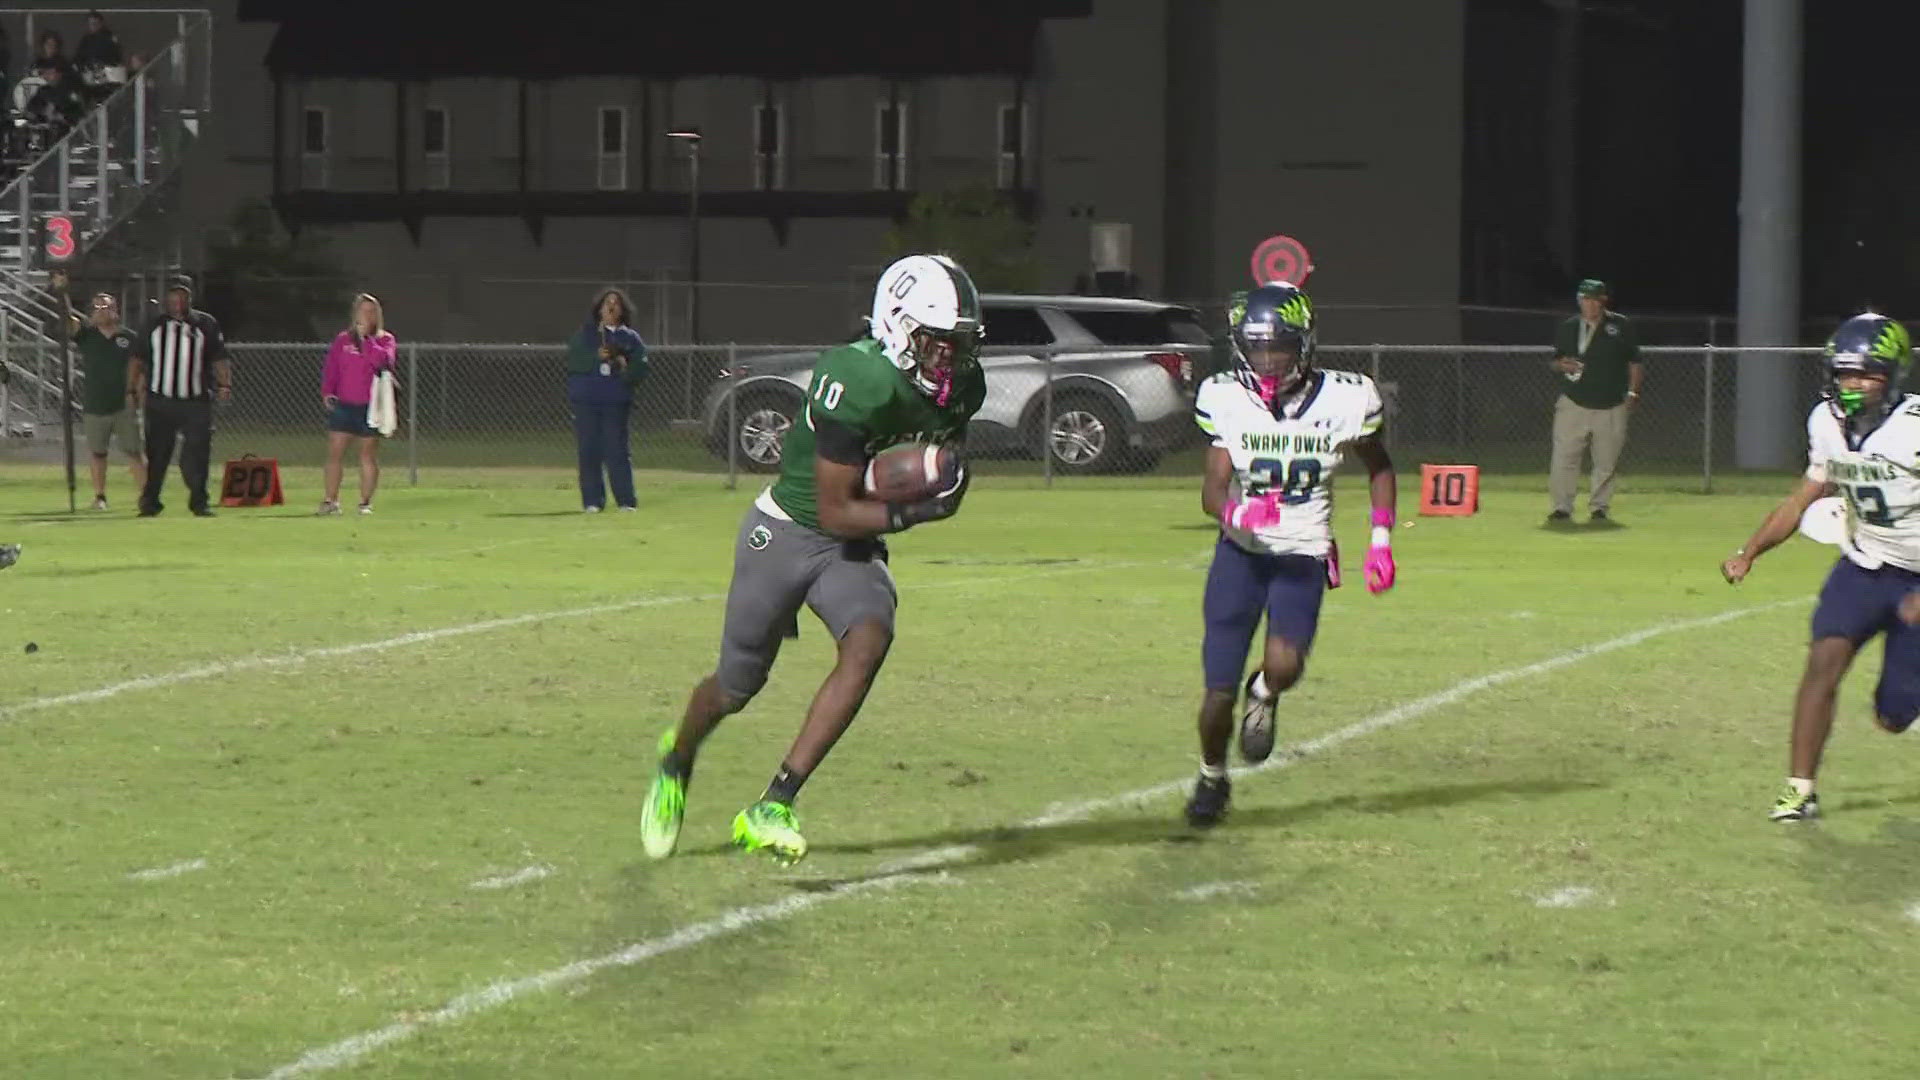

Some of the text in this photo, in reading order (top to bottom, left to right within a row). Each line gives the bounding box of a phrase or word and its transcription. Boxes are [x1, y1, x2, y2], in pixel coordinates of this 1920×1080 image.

[45, 217, 75, 258] 3
[888, 270, 917, 300] 10
[814, 374, 844, 411] 10
[1241, 432, 1332, 454] SWAMP OWLS
[228, 466, 272, 498] 20
[1430, 473, 1465, 506] 10
